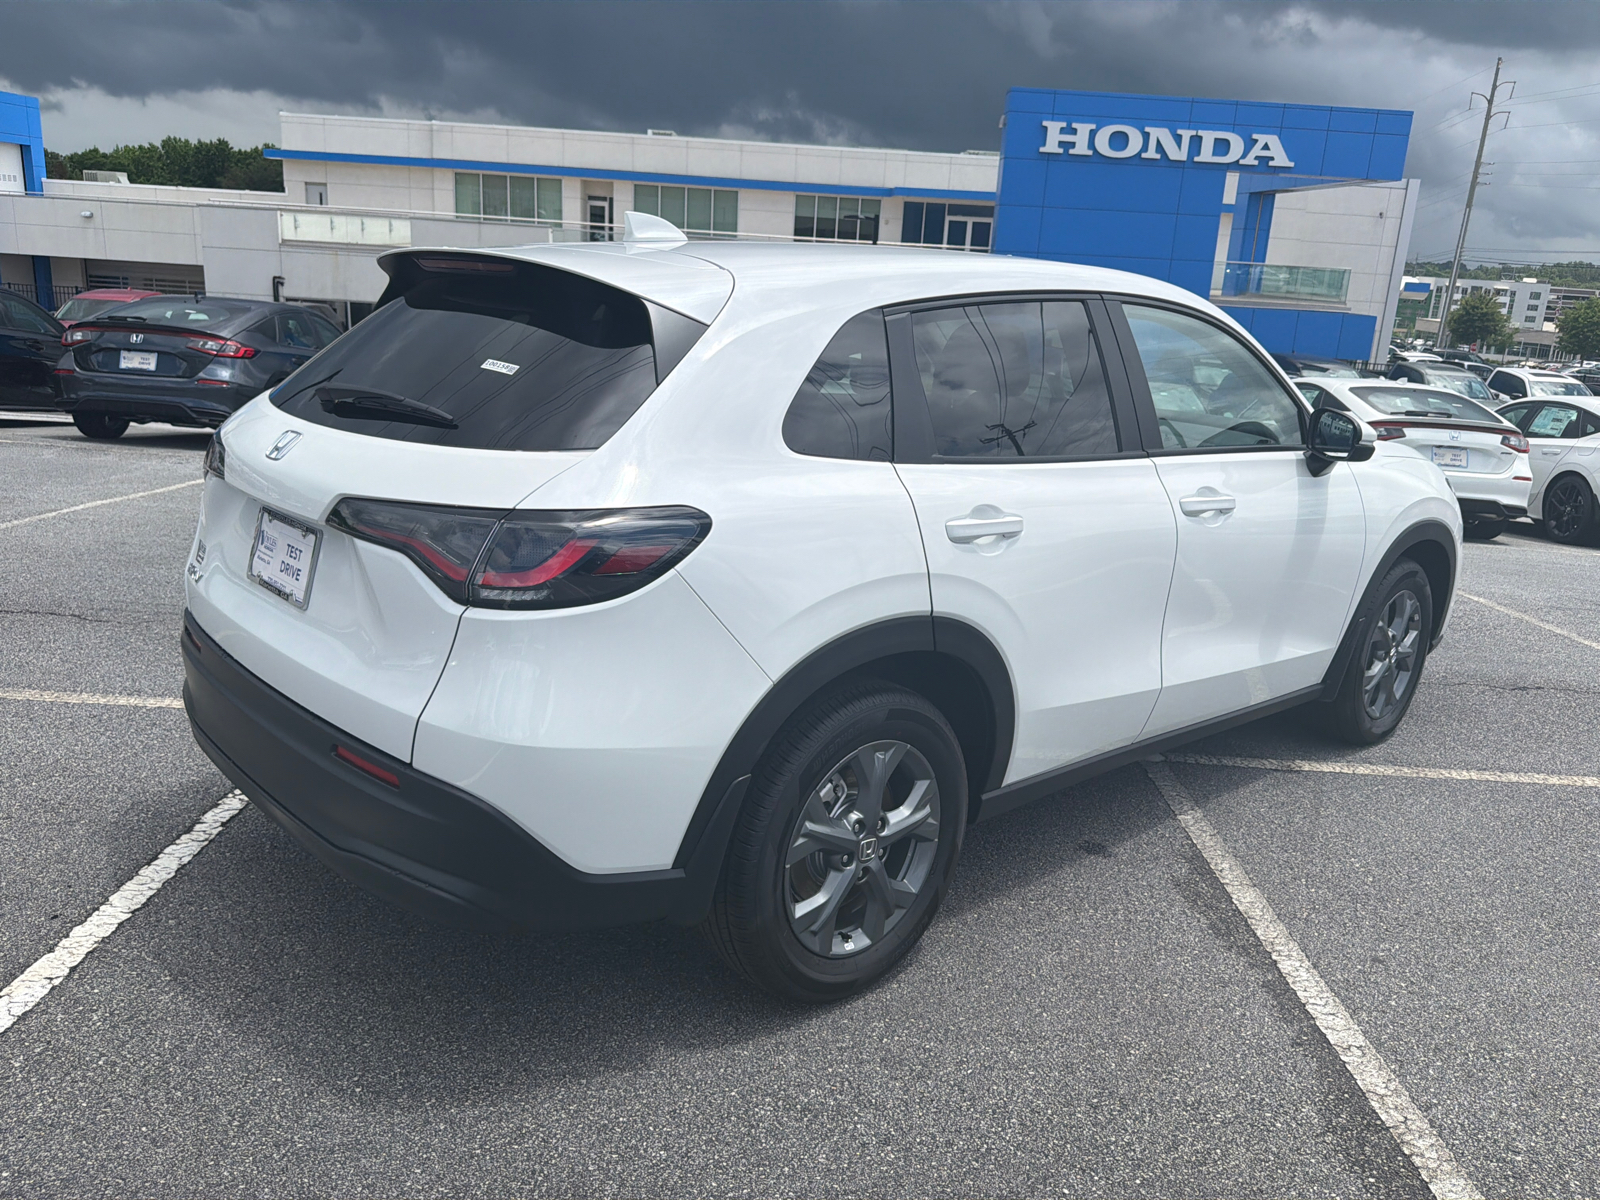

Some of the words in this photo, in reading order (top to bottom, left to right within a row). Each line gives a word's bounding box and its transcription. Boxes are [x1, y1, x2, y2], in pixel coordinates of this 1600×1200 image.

[1038, 120, 1295, 168] HONDA
[285, 543, 303, 562] TEST
[280, 560, 302, 582] DRIVE
